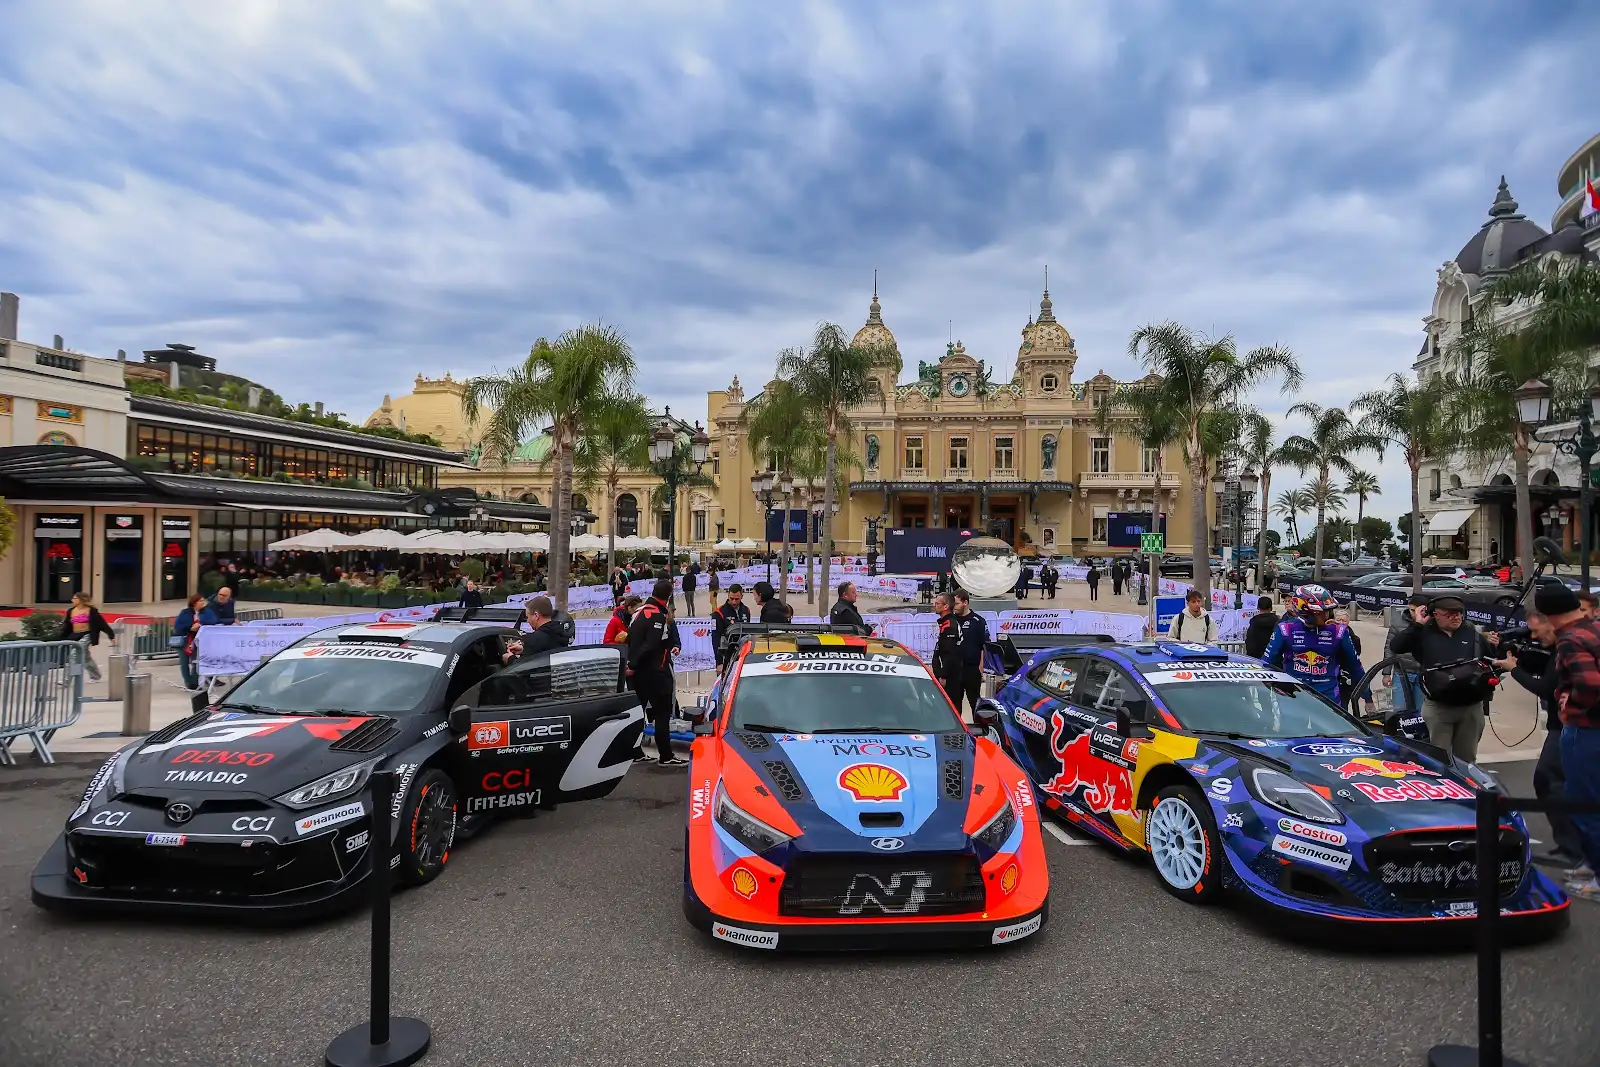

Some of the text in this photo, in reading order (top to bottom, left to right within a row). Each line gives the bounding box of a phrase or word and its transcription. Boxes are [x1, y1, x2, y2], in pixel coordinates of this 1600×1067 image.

[917, 547, 927, 557] OTT
[1466, 611, 1491, 620] MONTE-CARLO
[248, 639, 286, 648] CASINO
[798, 652, 865, 660] HYUNDAI
[1157, 660, 1263, 670] SafetyCulture
[1294, 662, 1328, 675] Red Bull
[423, 721, 449, 740] TAMADIC
[1020, 711, 1045, 733] Castrol
[516, 724, 564, 739] WRC
[1093, 730, 1122, 749] WRC
[496, 744, 544, 755] SafetyCulture
[831, 743, 932, 759] MOBIS
[1308, 743, 1371, 755] Ford
[170, 749, 276, 767] DENSO
[163, 770, 248, 785] TAMADIC
[390, 762, 419, 819] AUTOMOTIVE
[1017, 779, 1033, 807] WIA
[1351, 778, 1477, 803] Red Bull
[466, 789, 542, 814] [FIT-EASY]
[692, 788, 706, 820] WIA
[345, 832, 369, 851] OMP
[1292, 823, 1343, 844] Castrol
